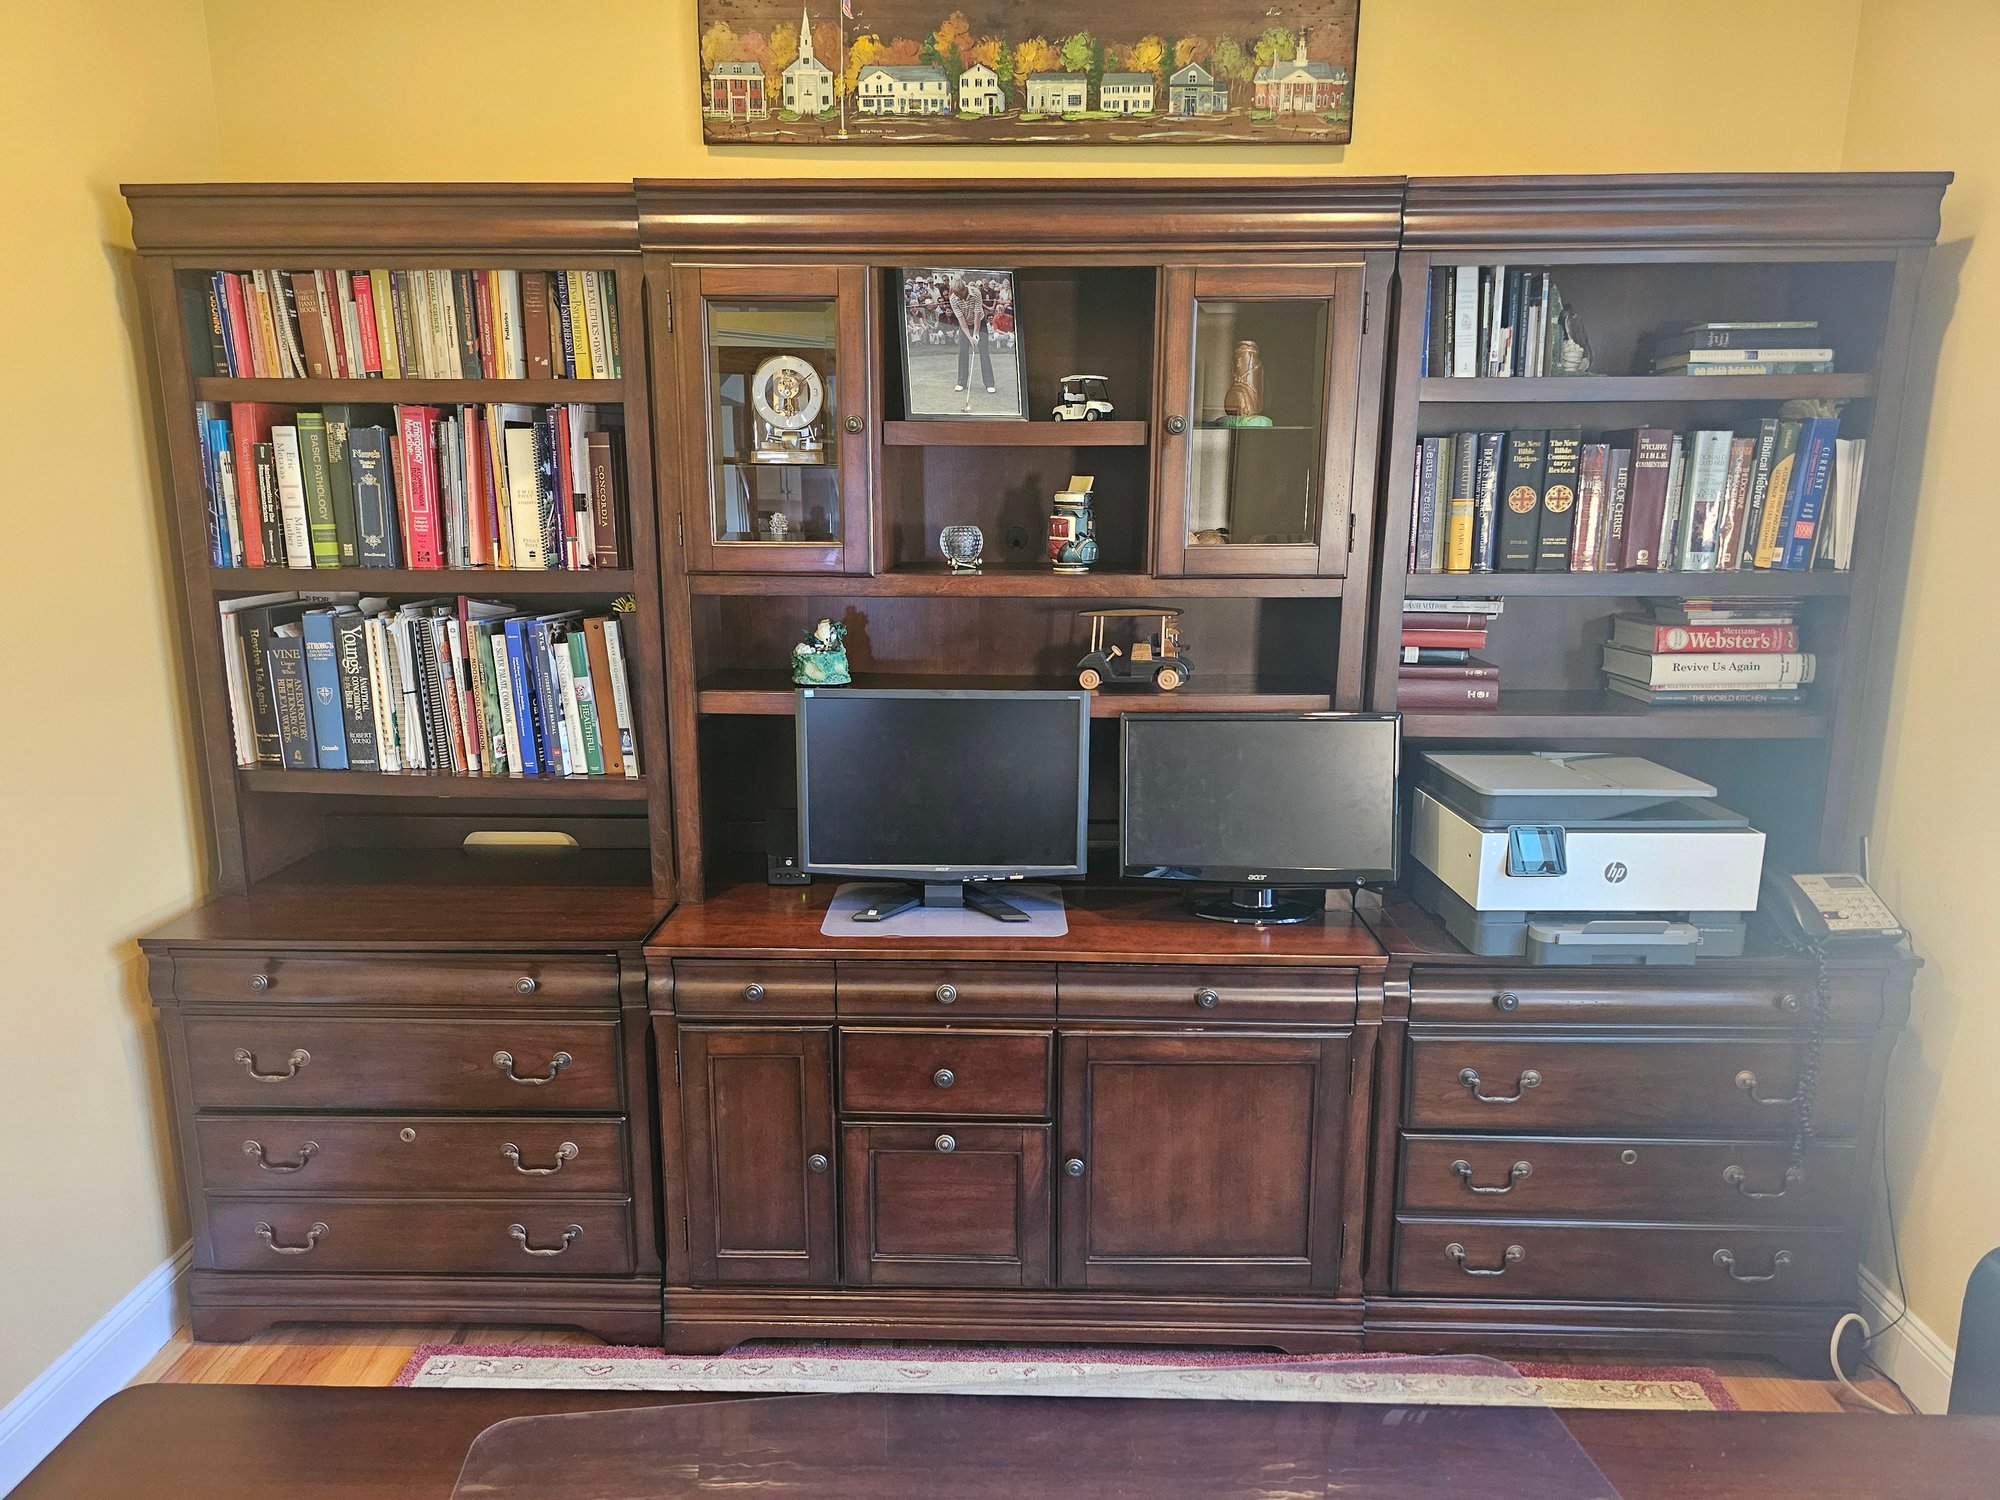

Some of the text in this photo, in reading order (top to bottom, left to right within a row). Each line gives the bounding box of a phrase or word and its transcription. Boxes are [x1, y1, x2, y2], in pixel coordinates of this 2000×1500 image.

[429, 272, 437, 301] CLINICAL
[277, 315, 287, 351] PATHOLOGY
[484, 322, 492, 355] CARDIOLOGY
[561, 304, 573, 353] PSYCHOHERESY
[571, 301, 583, 351] PSYCHOHERESY
[590, 308, 602, 363] ETHICS DAVIS
[814, 388, 820, 397] 3
[195, 408, 204, 443] Electronics
[404, 418, 413, 456] Medicine:
[412, 421, 423, 464] Emergency
[1783, 429, 1792, 450] Holladay
[276, 443, 286, 480] Metaxas
[286, 452, 295, 471] Eric
[310, 434, 328, 520] BASIC PATHOLOGY
[1482, 448, 1494, 478] ROGET'S
[1752, 436, 1774, 509] Biblical Hebrew
[1771, 469, 1780, 491] LEXICON
[1814, 447, 1830, 490] CURRENT
[257, 464, 269, 523] Nonmathematician
[263, 464, 271, 504] Mathematics
[411, 480, 419, 495] GUIDE
[416, 471, 424, 507] COMPREHENSIVE
[598, 465, 608, 528] CONCORDIA
[1422, 445, 1435, 524] Jesus Freaks
[1457, 438, 1470, 557] TOTAL TRUTH PEARCEY
[1736, 467, 1750, 510] THE DOCTRINE
[1779, 472, 1788, 493] CONCISE
[1612, 467, 1628, 540] LIFE OF CHRIST
[1766, 510, 1774, 520] OLD
[1775, 494, 1785, 513] HEBREW
[285, 518, 294, 547] Luther
[294, 517, 303, 548] Martin
[1761, 521, 1771, 551] TESTAMENT
[1768, 525, 1778, 551] ARAMAIC
[272, 650, 301, 659] VINE
[340, 625, 363, 674] Young's
[1688, 632, 1770, 649] Webster's
[250, 628, 267, 715] Revive Us Again
[496, 647, 513, 724] SILVER PALATE COOKBOOK
[1672, 662, 1760, 672] Revive Us Again
[277, 678, 291, 743] BIBLICAL WORDS
[285, 678, 298, 737] DICTIONARY OF
[294, 678, 308, 741] AN EXPOSITORY
[345, 690, 353, 710] BIBLE
[352, 676, 362, 720] CONCORDANCE
[360, 676, 369, 712] ANALYTICAL
[471, 657, 481, 707] MOOSEWOOD
[476, 709, 486, 750] COOKBOOK
[581, 704, 595, 754] HEALTHFUL
